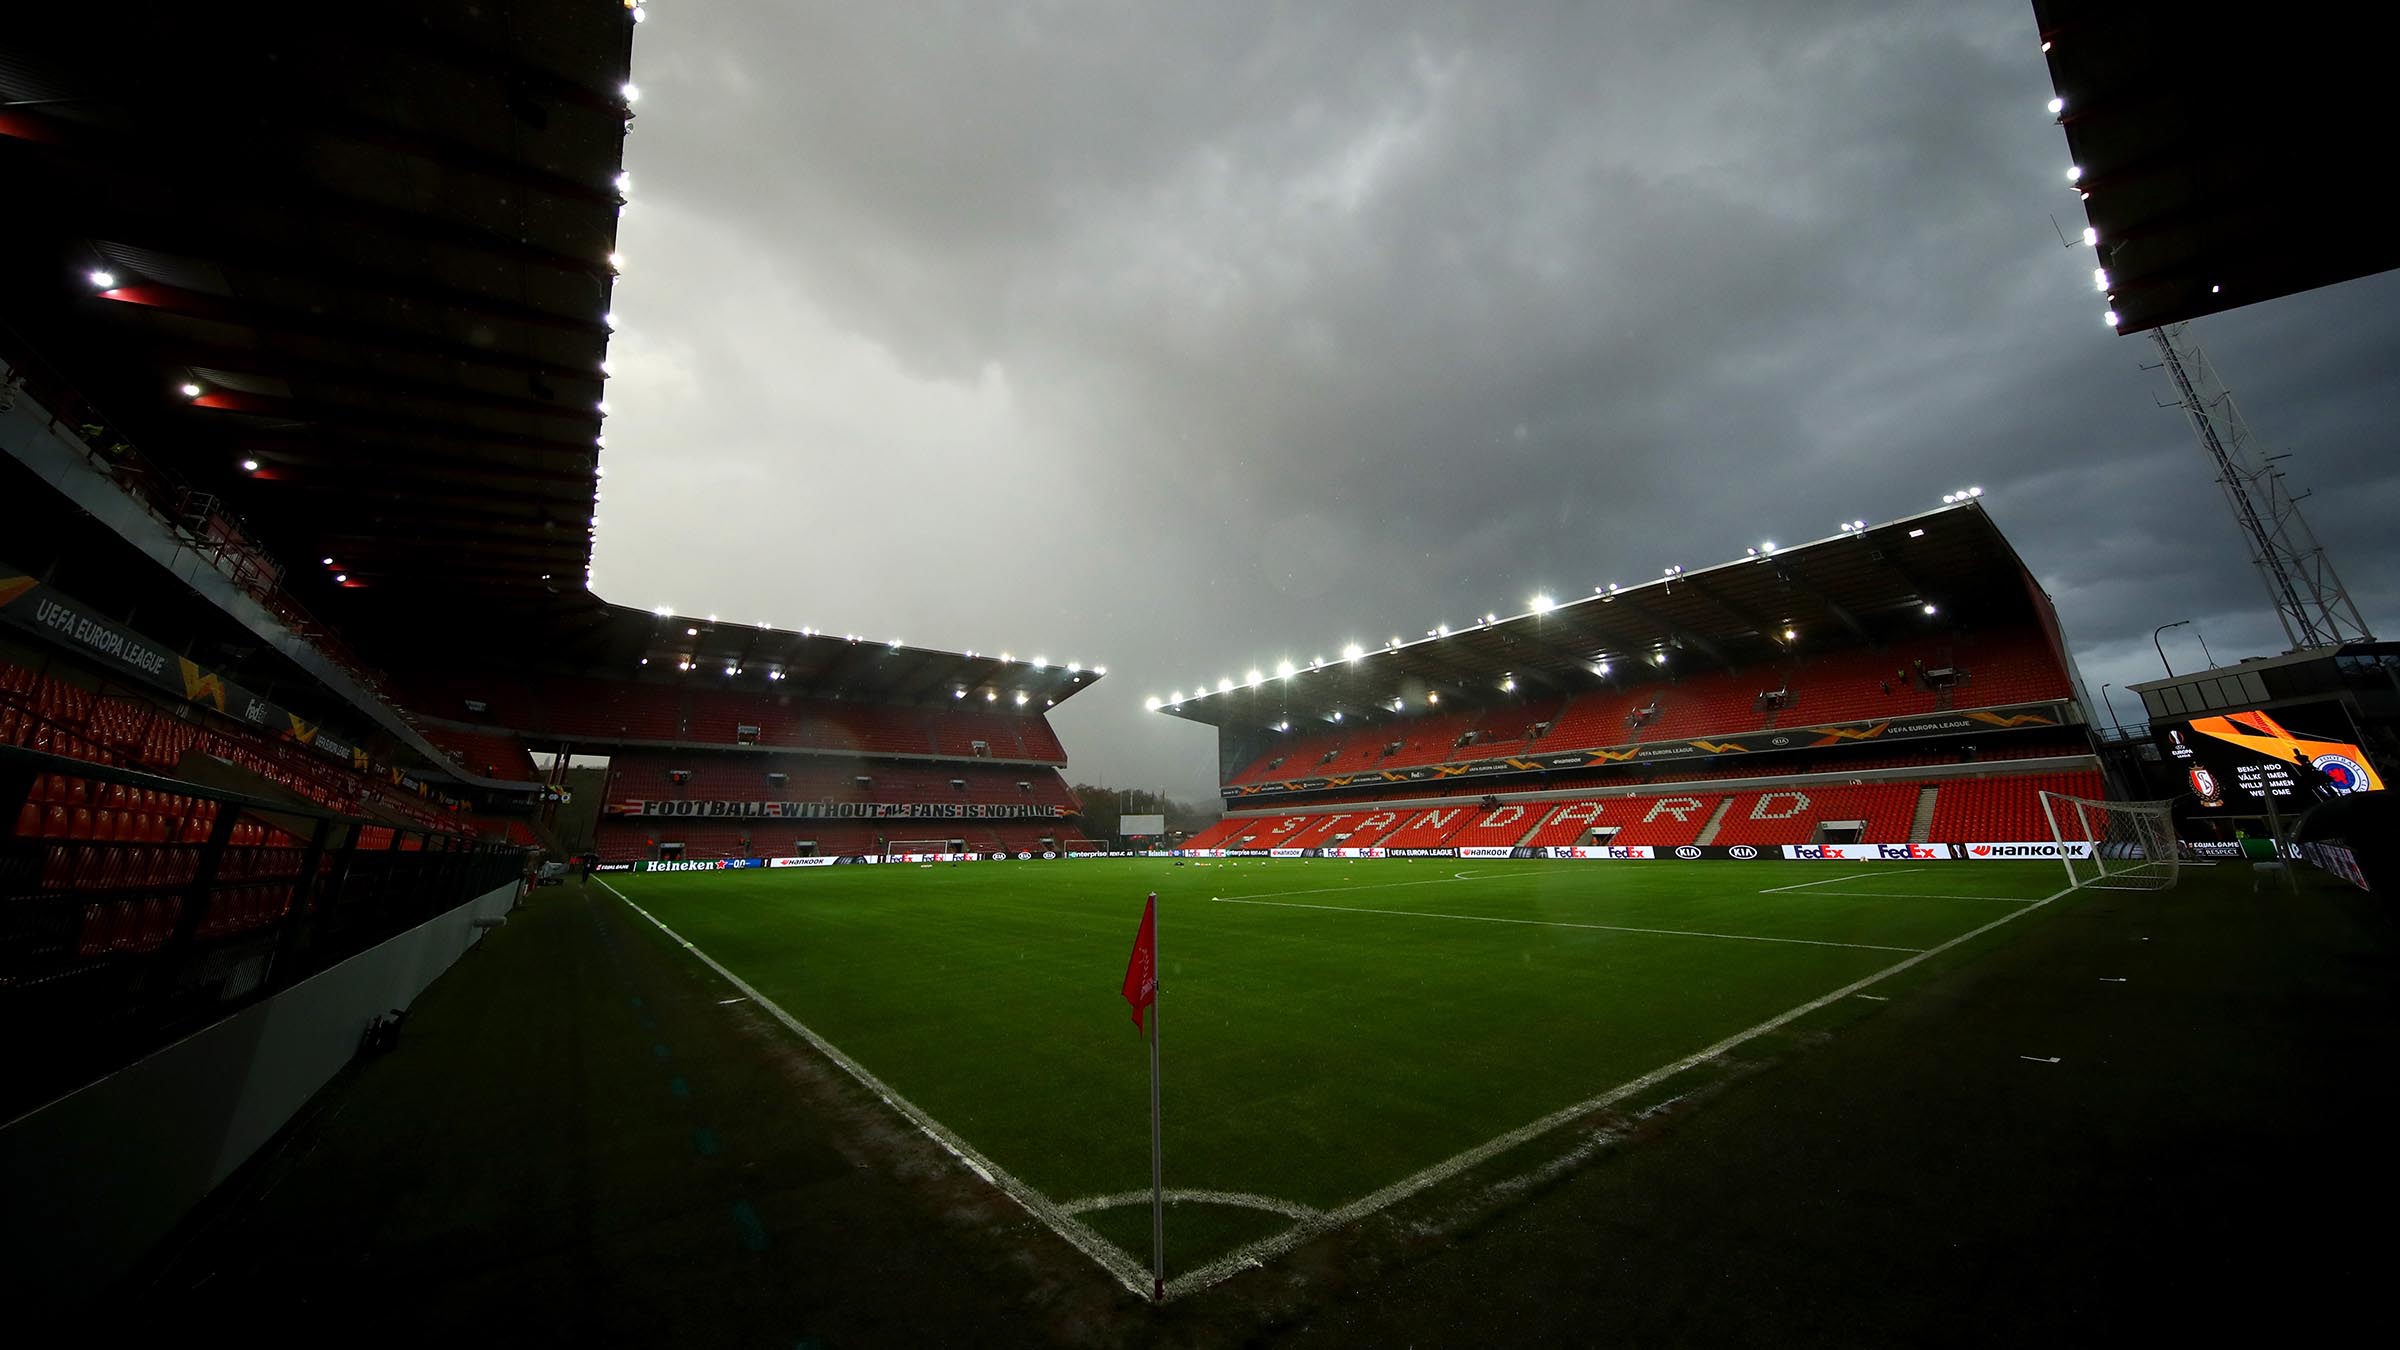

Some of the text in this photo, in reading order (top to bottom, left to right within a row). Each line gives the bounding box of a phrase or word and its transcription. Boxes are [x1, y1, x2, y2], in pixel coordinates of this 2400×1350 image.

[37, 598, 166, 676] UEFA EUROPA LEAGUE
[1908, 724, 1938, 732] EUROPA
[1940, 720, 1971, 729] LEAGUE
[2239, 779, 2294, 789] WILLKMMEN
[2249, 788, 2291, 797] WEOME
[642, 800, 771, 817] FOOTBALL
[781, 802, 882, 818] WITHOUT
[909, 804, 956, 818] FANS
[961, 804, 979, 818] IS
[985, 804, 1055, 818] NOTHING
[1391, 848, 1453, 857] UEFA EUROPA LEAGUE
[1554, 847, 1587, 858] FedEx
[1608, 846, 1644, 858] FedEx
[1794, 845, 1845, 859] FedEx
[1877, 844, 1937, 859] FedEx
[646, 860, 714, 872] Heineken
